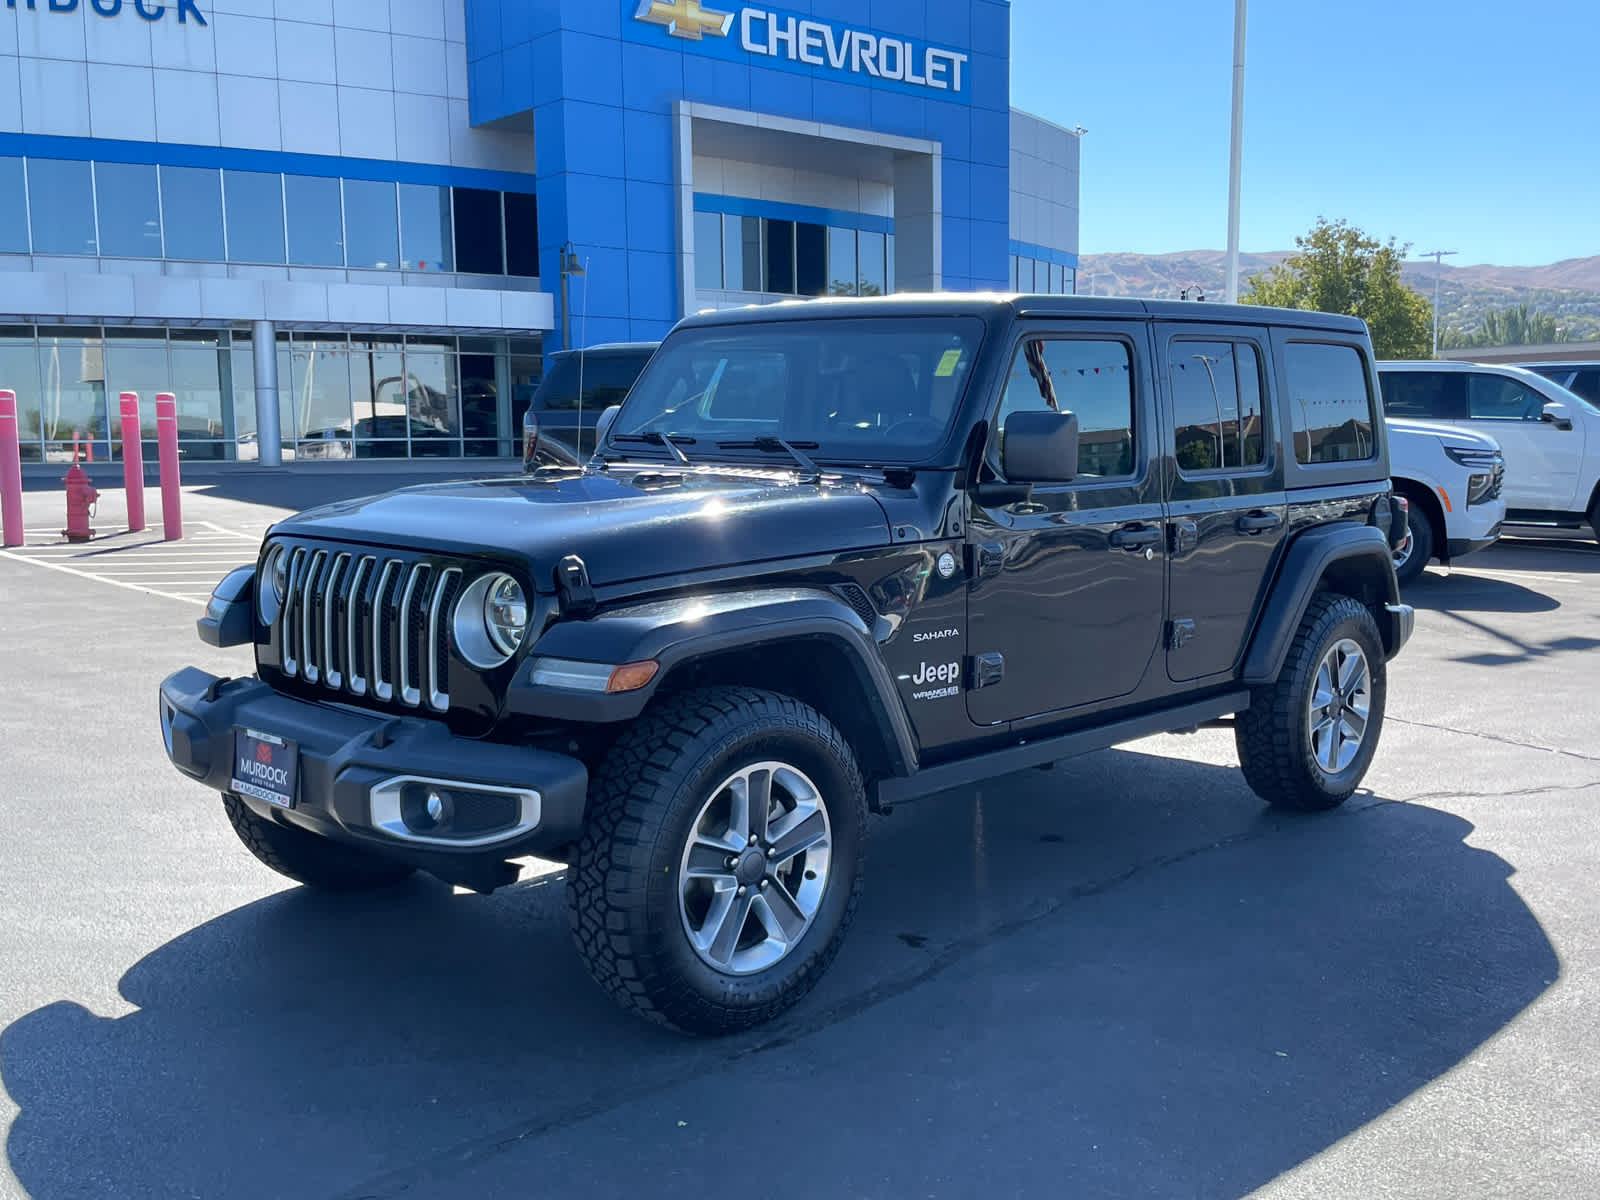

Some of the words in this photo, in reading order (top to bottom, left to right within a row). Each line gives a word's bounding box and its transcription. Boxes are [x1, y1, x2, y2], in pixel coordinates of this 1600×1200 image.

[740, 7, 968, 92] CHEVROLET
[913, 628, 960, 642] SAHARA
[912, 661, 960, 685] Jeep
[240, 757, 288, 785] MURDOCK
